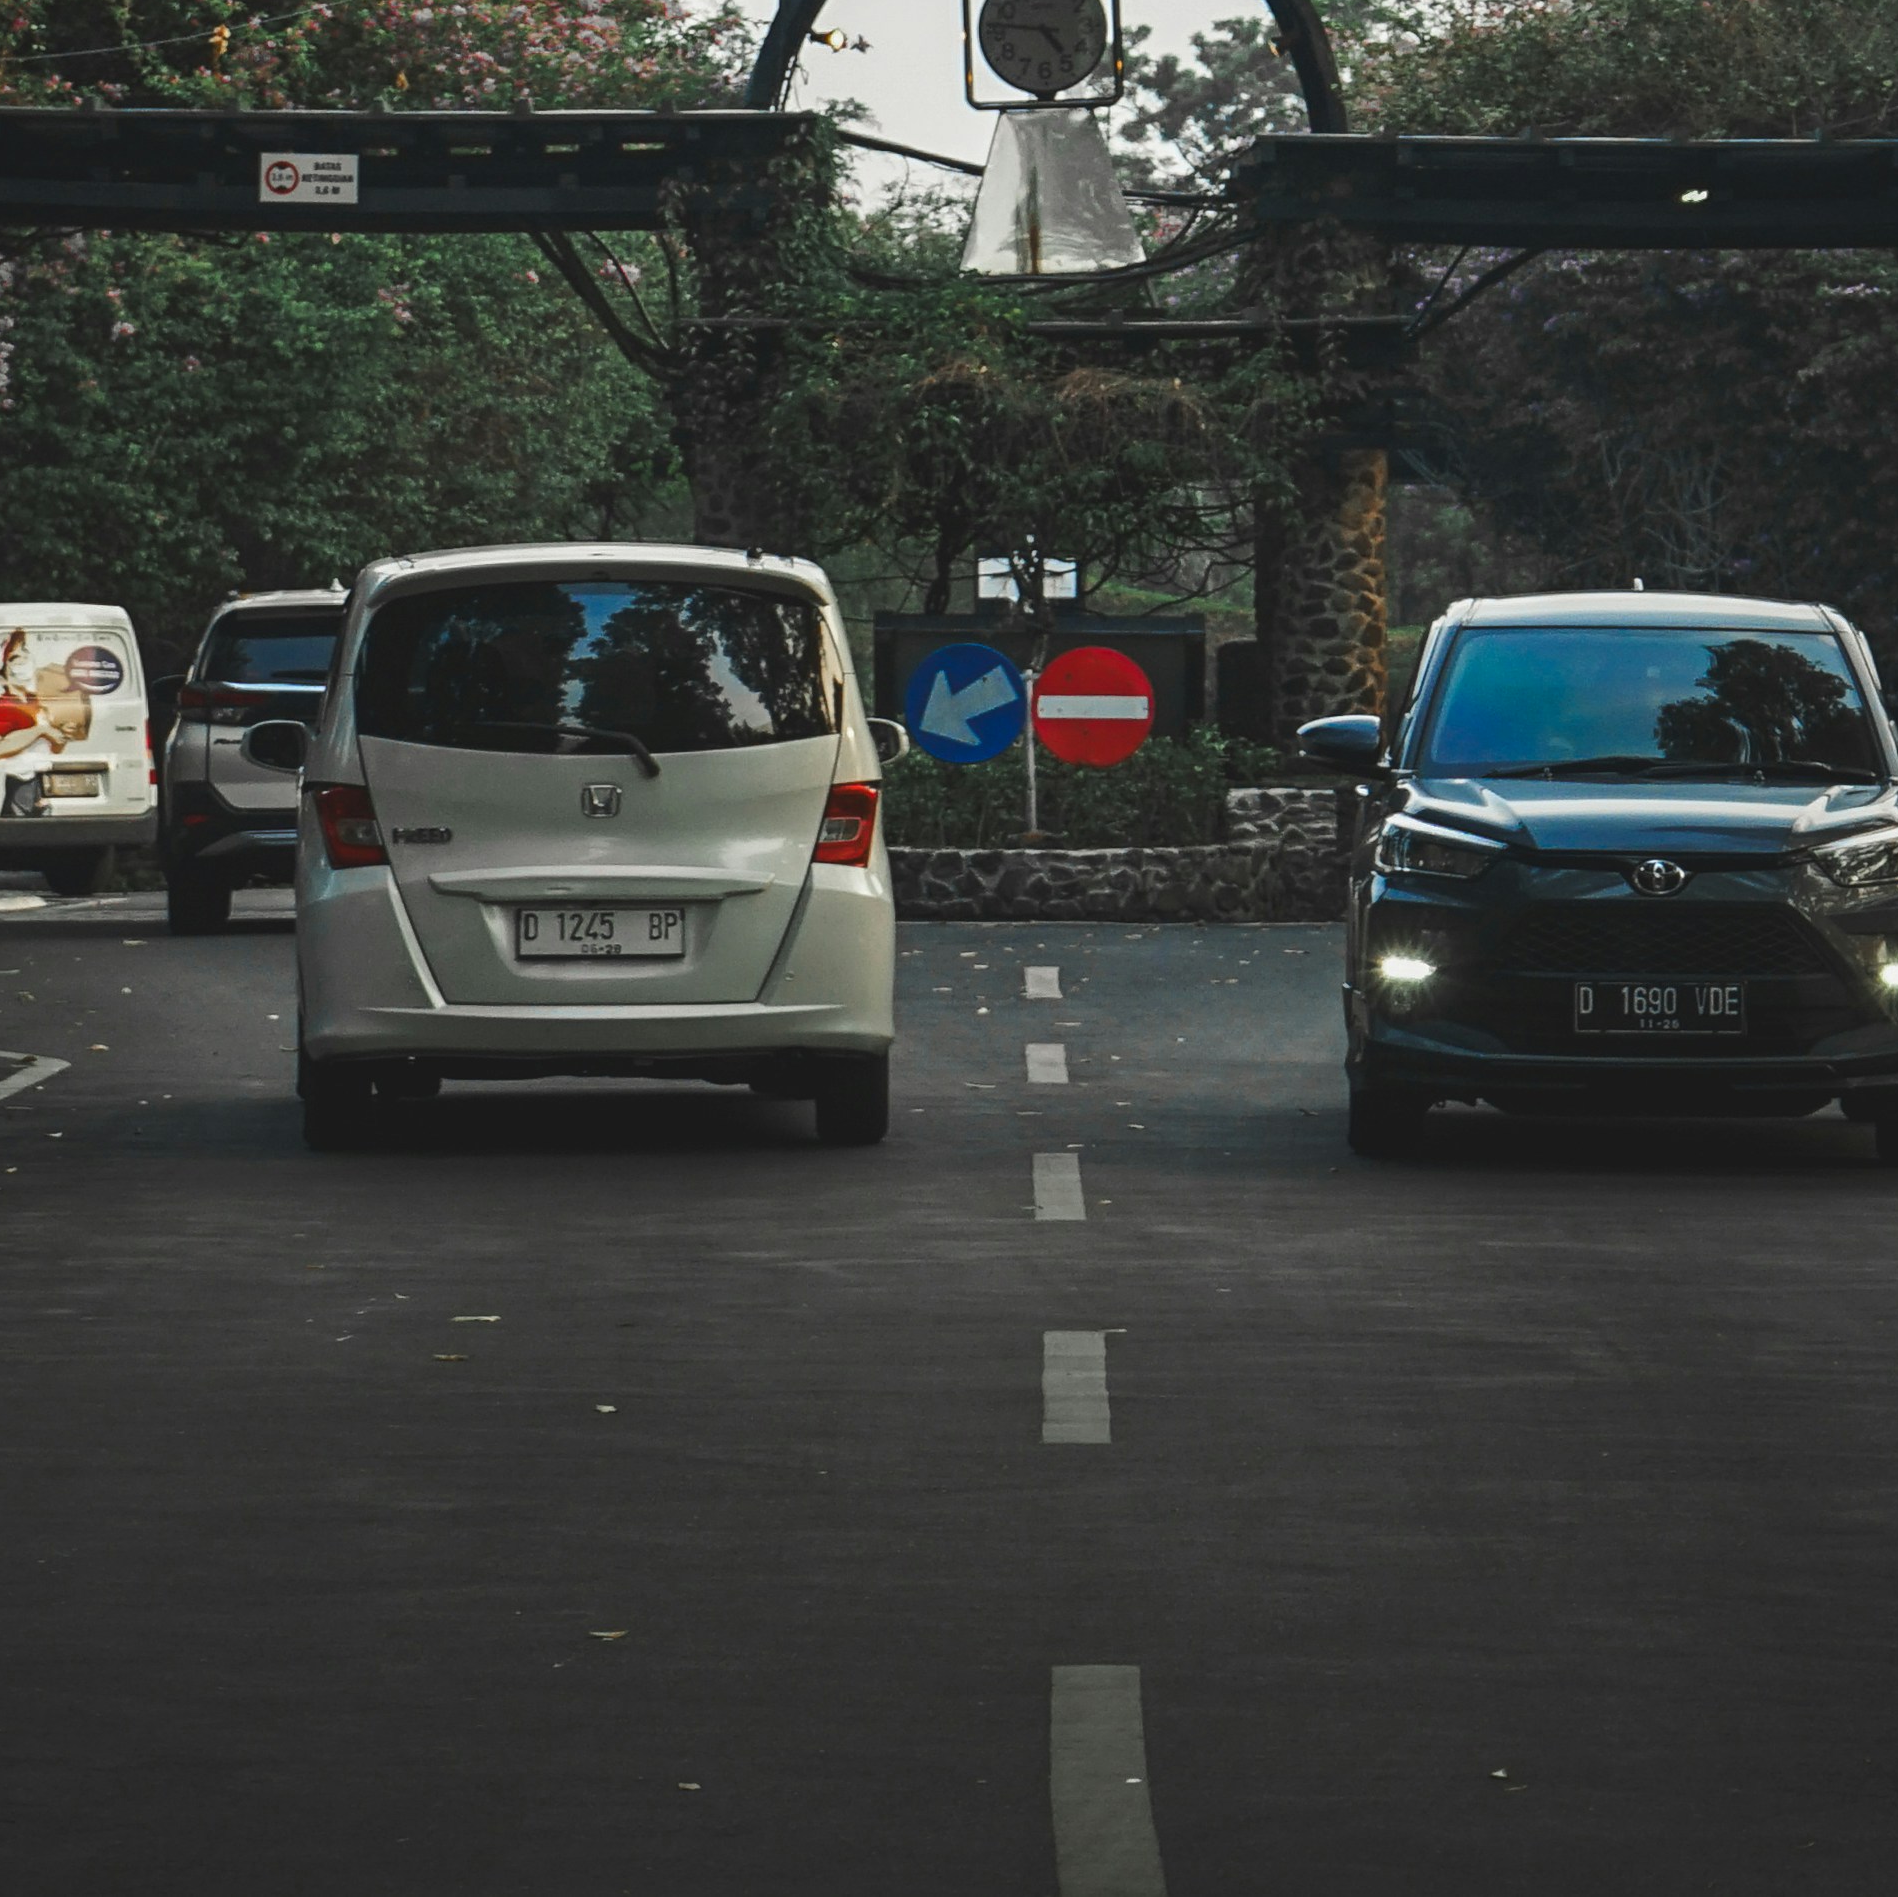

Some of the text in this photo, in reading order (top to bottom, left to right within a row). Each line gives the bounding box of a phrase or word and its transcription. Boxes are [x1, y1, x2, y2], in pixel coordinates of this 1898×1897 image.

[523, 912, 678, 941] D 1245 BP
[1580, 986, 1738, 1015] D 1690 VDE
